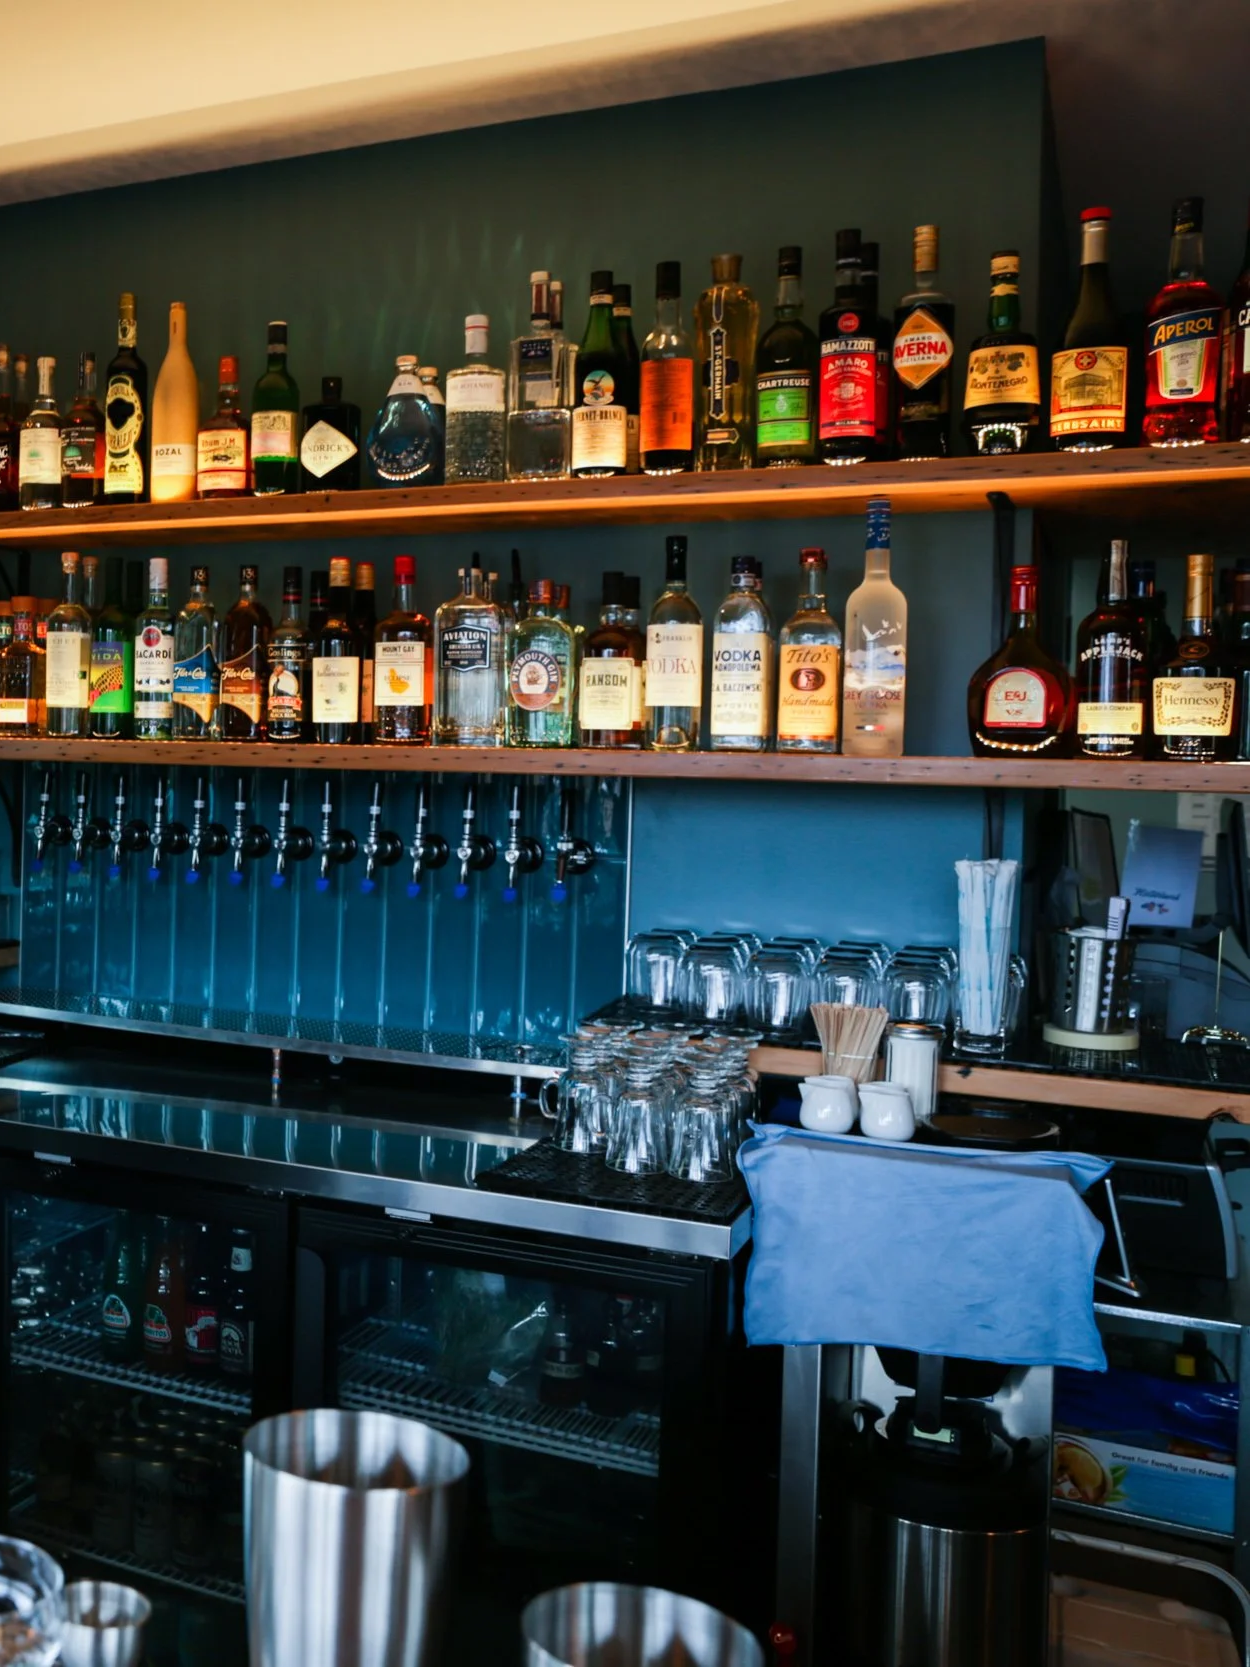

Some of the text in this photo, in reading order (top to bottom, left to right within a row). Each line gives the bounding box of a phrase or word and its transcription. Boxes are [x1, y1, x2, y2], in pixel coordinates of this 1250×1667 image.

[1153, 317, 1214, 346] APEROL
[895, 341, 948, 360] AVERNA
[828, 357, 868, 371] AMARO
[758, 378, 810, 390] CHARTREUSE
[304, 444, 351, 453] NDRICK'S
[443, 631, 487, 642] AVIATION
[714, 649, 762, 662] VODKA
[786, 648, 832, 665] Tito's
[1080, 645, 1143, 662] APPLEJACK
[512, 652, 558, 682] PLYMOUTH GIN
[586, 674, 628, 687] RANSOM
[1164, 694, 1221, 709] Hennessy
[1151, 1459, 1179, 1472] family
[1198, 1468, 1229, 1480] friends
